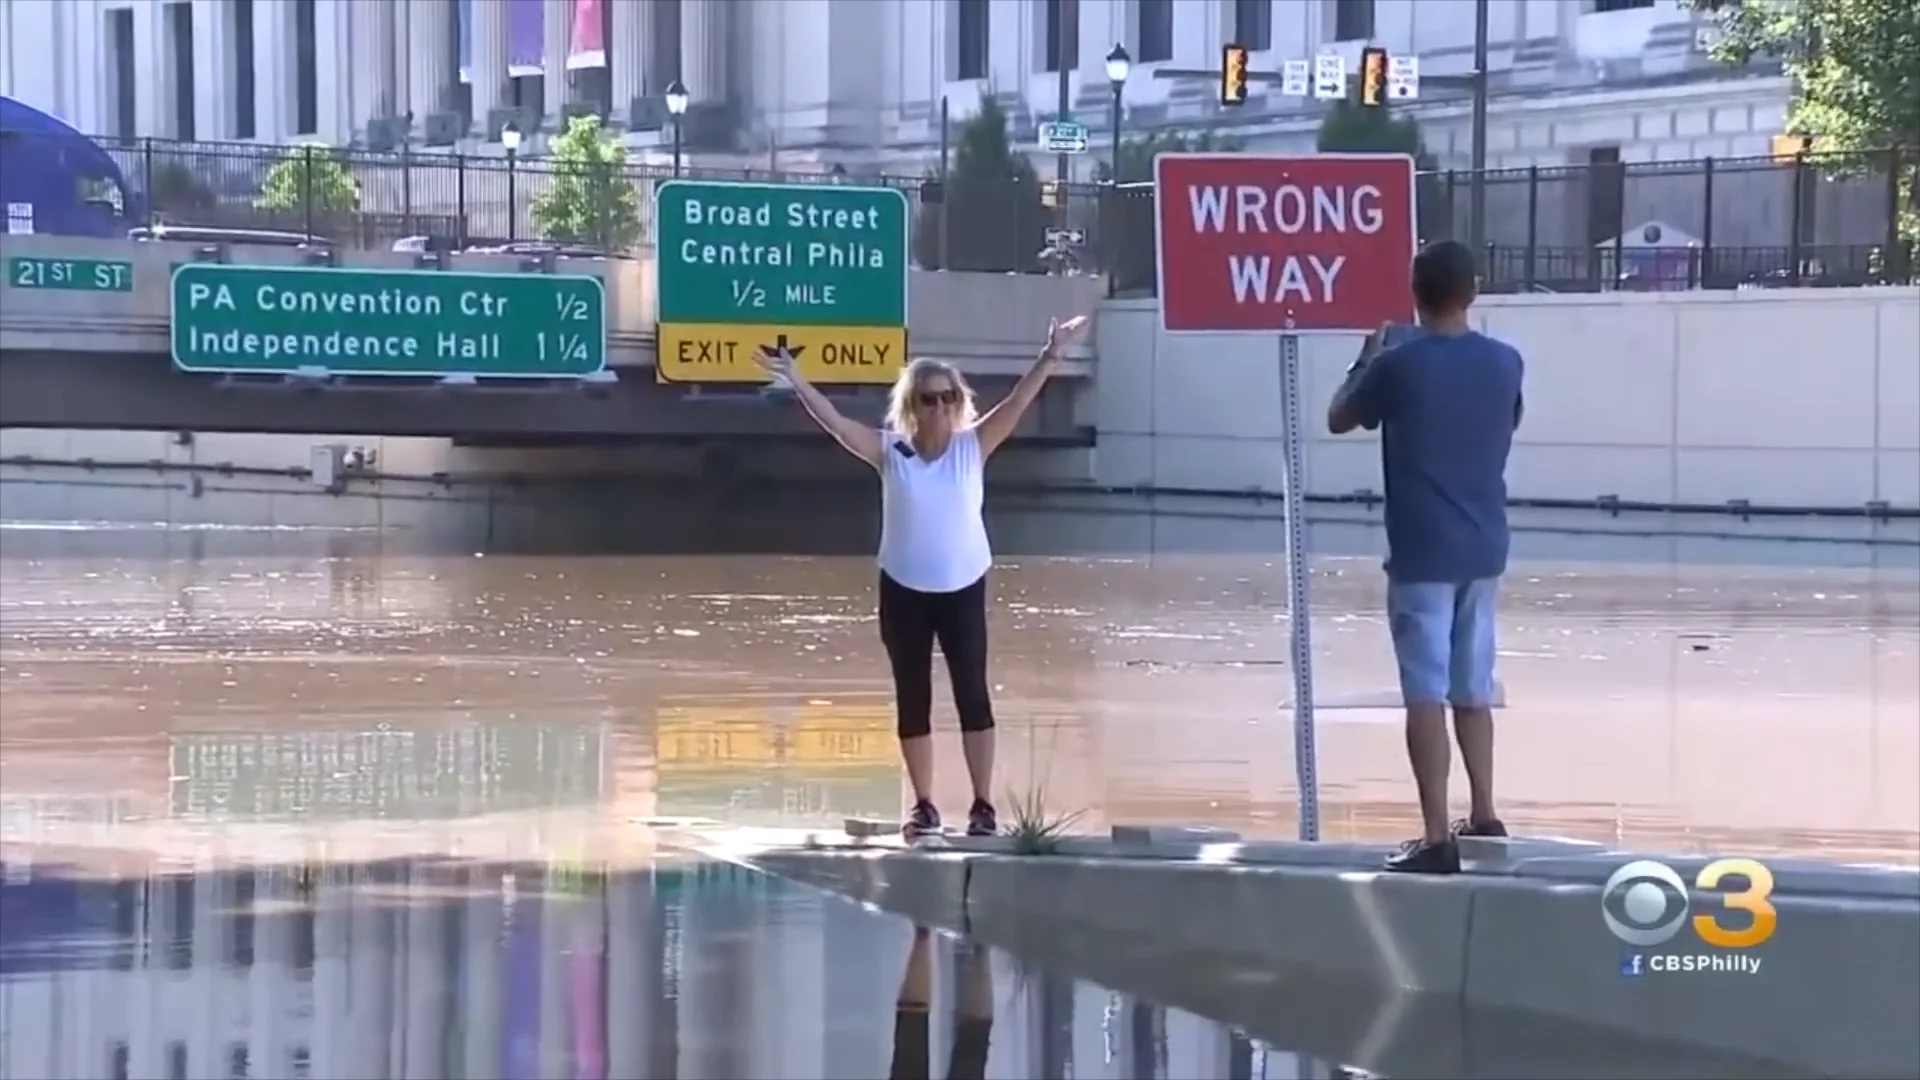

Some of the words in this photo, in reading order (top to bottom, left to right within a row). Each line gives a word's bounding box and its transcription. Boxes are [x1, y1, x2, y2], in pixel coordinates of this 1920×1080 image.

[685, 199, 770, 226] Broad
[787, 203, 879, 230] Street
[1188, 185, 1384, 234] WRONG
[681, 239, 791, 265] Central
[809, 242, 883, 268] Phila
[95, 264, 126, 288] ST
[1229, 255, 1346, 304] WAY
[190, 283, 236, 310] PA
[257, 285, 441, 315] Convention
[460, 291, 508, 317] Ctr
[786, 284, 836, 304] MILE
[190, 326, 418, 359] Independence
[437, 331, 499, 359] Hall
[678, 341, 738, 363] EXIT
[821, 344, 890, 365] ONLY
